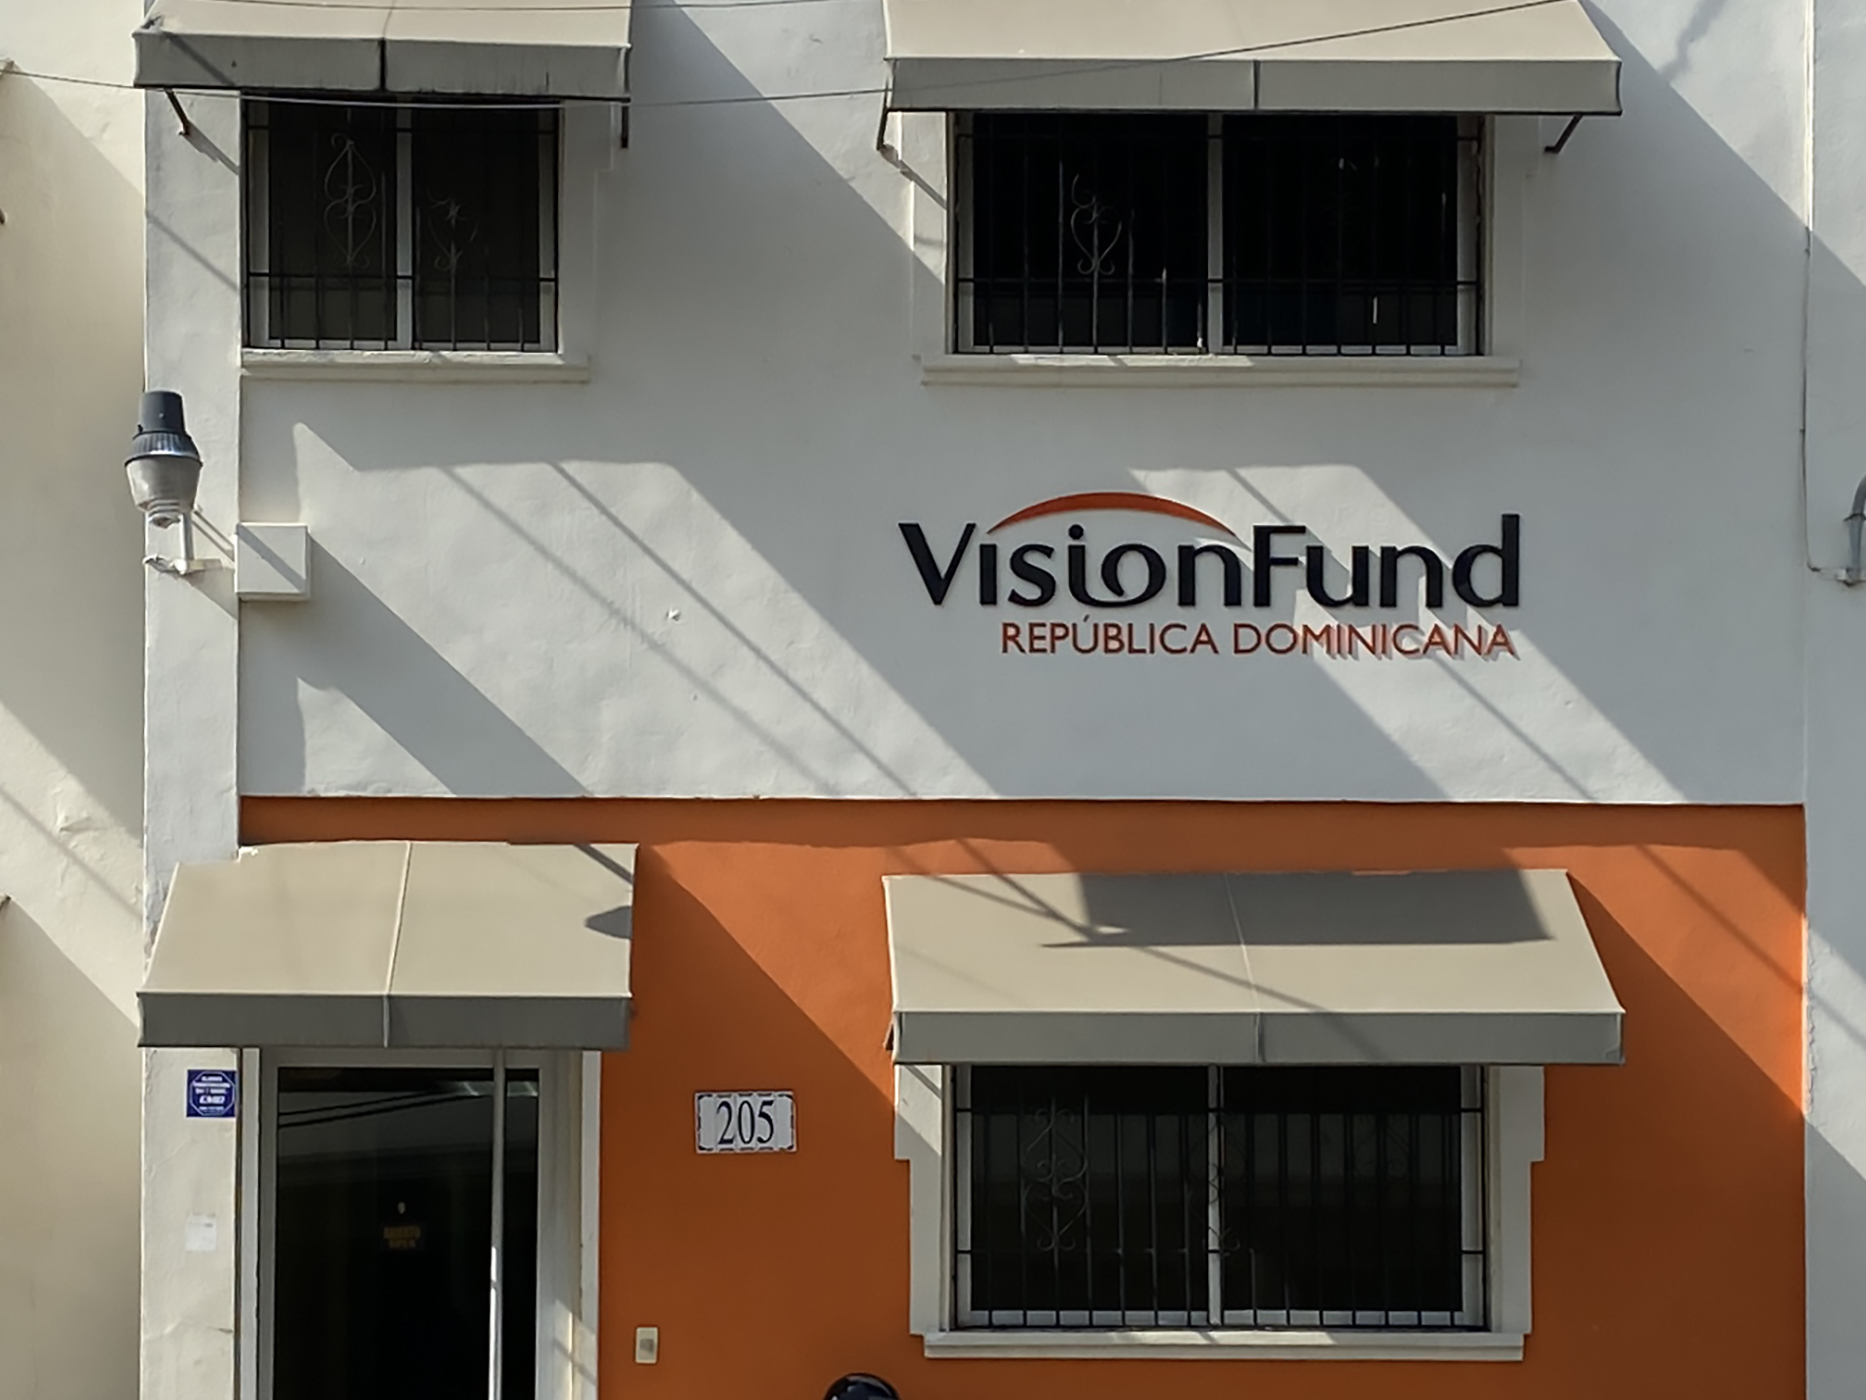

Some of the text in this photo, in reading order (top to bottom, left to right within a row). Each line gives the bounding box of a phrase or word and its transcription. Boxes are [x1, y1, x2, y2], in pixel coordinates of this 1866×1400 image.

[898, 513, 1520, 609] VisionFund
[1001, 614, 1515, 656] REPÚBLICA DOMINICANA
[716, 1099, 775, 1145] 205
